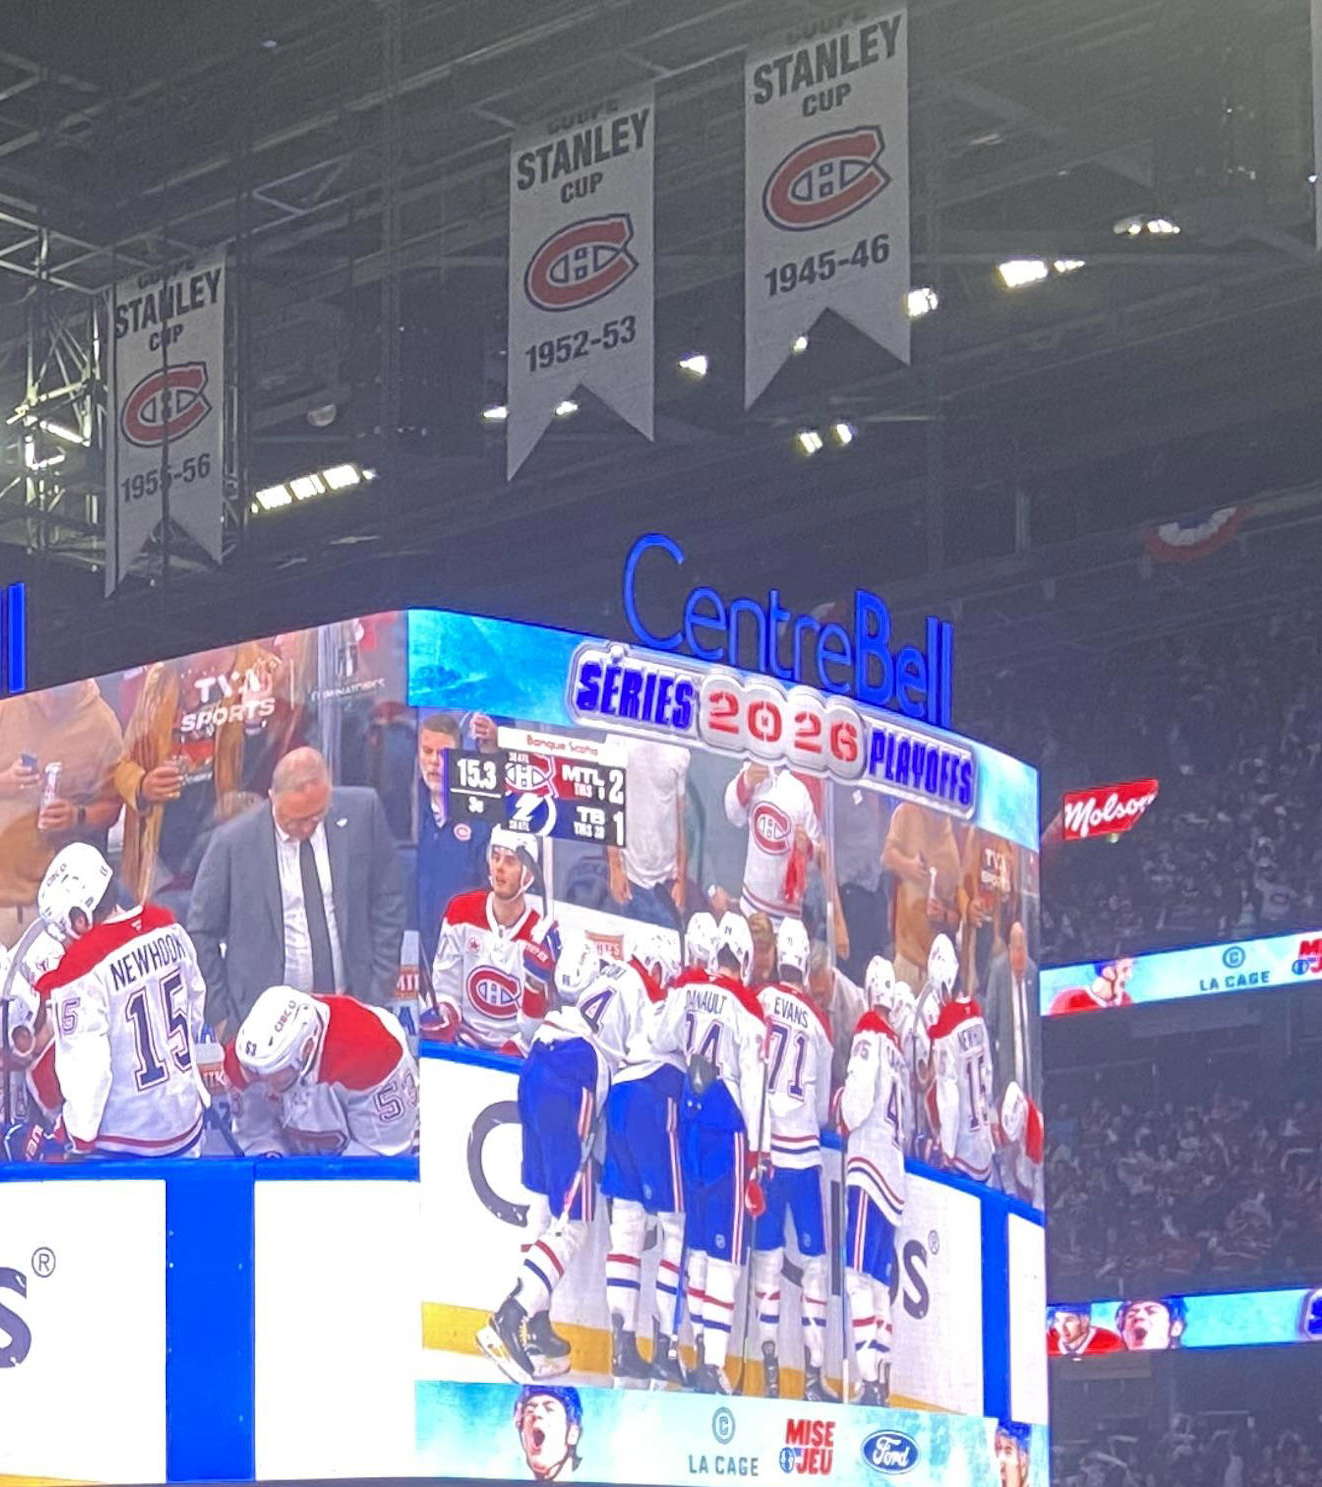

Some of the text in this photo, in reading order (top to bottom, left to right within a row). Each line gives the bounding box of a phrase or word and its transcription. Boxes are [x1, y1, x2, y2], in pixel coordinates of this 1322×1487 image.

[753, 15, 901, 104] STANLEY
[802, 82, 851, 117] CUP
[517, 108, 650, 190] STANLEY
[560, 172, 603, 204] CUP
[765, 233, 891, 297] 1945-46
[115, 267, 223, 340] STANLEY
[525, 315, 637, 372] 1952-53
[623, 532, 954, 730] CentreBell
[180, 697, 276, 733] SPORTS
[575, 656, 972, 807] SÉRIES 2026 PLAYOFFS
[456, 758, 497, 791] 15.3
[561, 764, 624, 805] MTL 2
[576, 805, 624, 846] TB 1
[1064, 792, 1157, 839] Molson
[1199, 971, 1271, 992] LA CAGE
[125, 968, 193, 1092] 15
[773, 996, 809, 1029] EVANS
[767, 1020, 809, 1101] 71
[785, 1418, 836, 1448] MISE
[872, 1436, 911, 1470] Ford
[689, 1454, 760, 1477] LA CAGE
[795, 1449, 834, 1476] JEU
